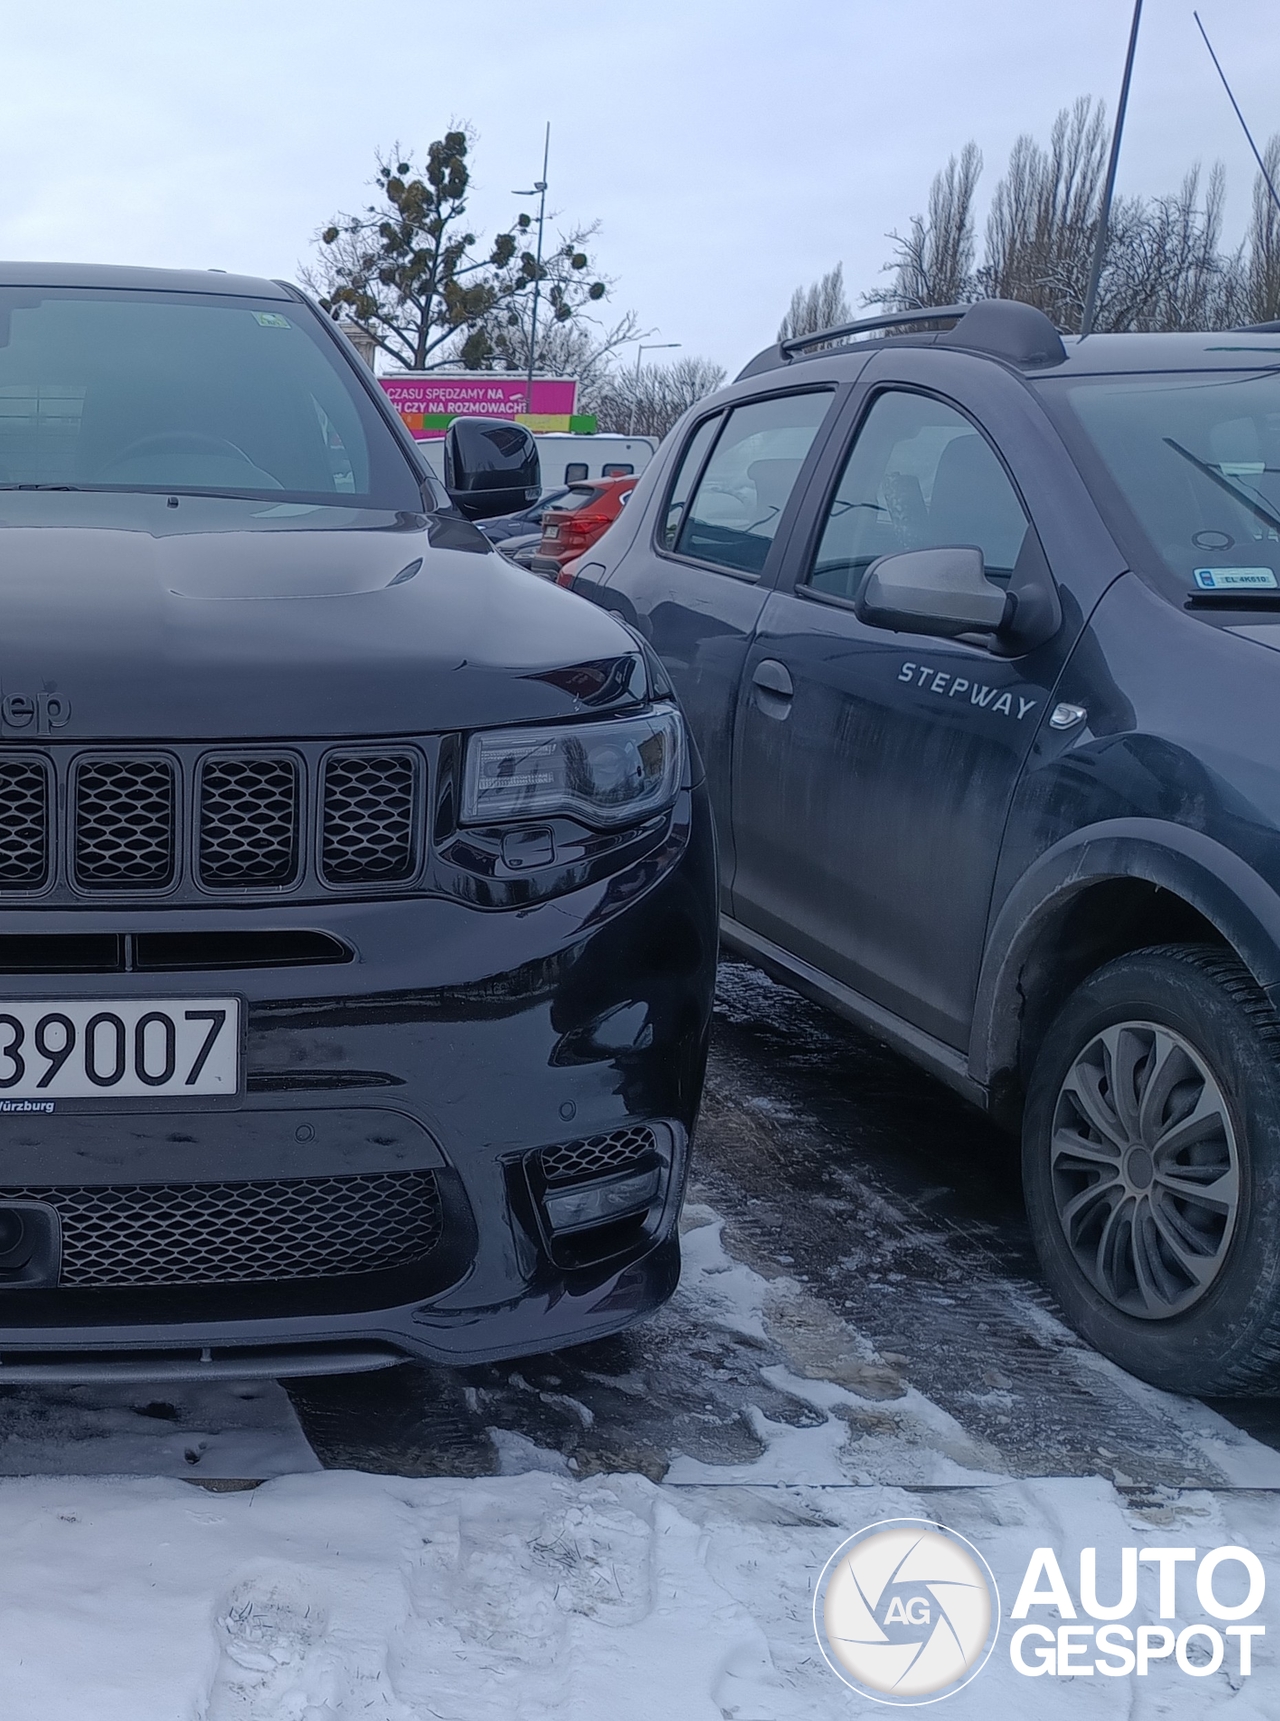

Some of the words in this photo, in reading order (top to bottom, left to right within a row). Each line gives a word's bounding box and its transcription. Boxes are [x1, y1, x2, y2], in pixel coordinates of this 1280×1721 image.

[387, 388, 422, 400] CZASU
[425, 388, 485, 402] SPĘDZAMY
[487, 388, 504, 400] NA
[404, 402, 426, 413] CZY
[428, 402, 444, 413] NA
[898, 661, 1037, 720] STEPWAY
